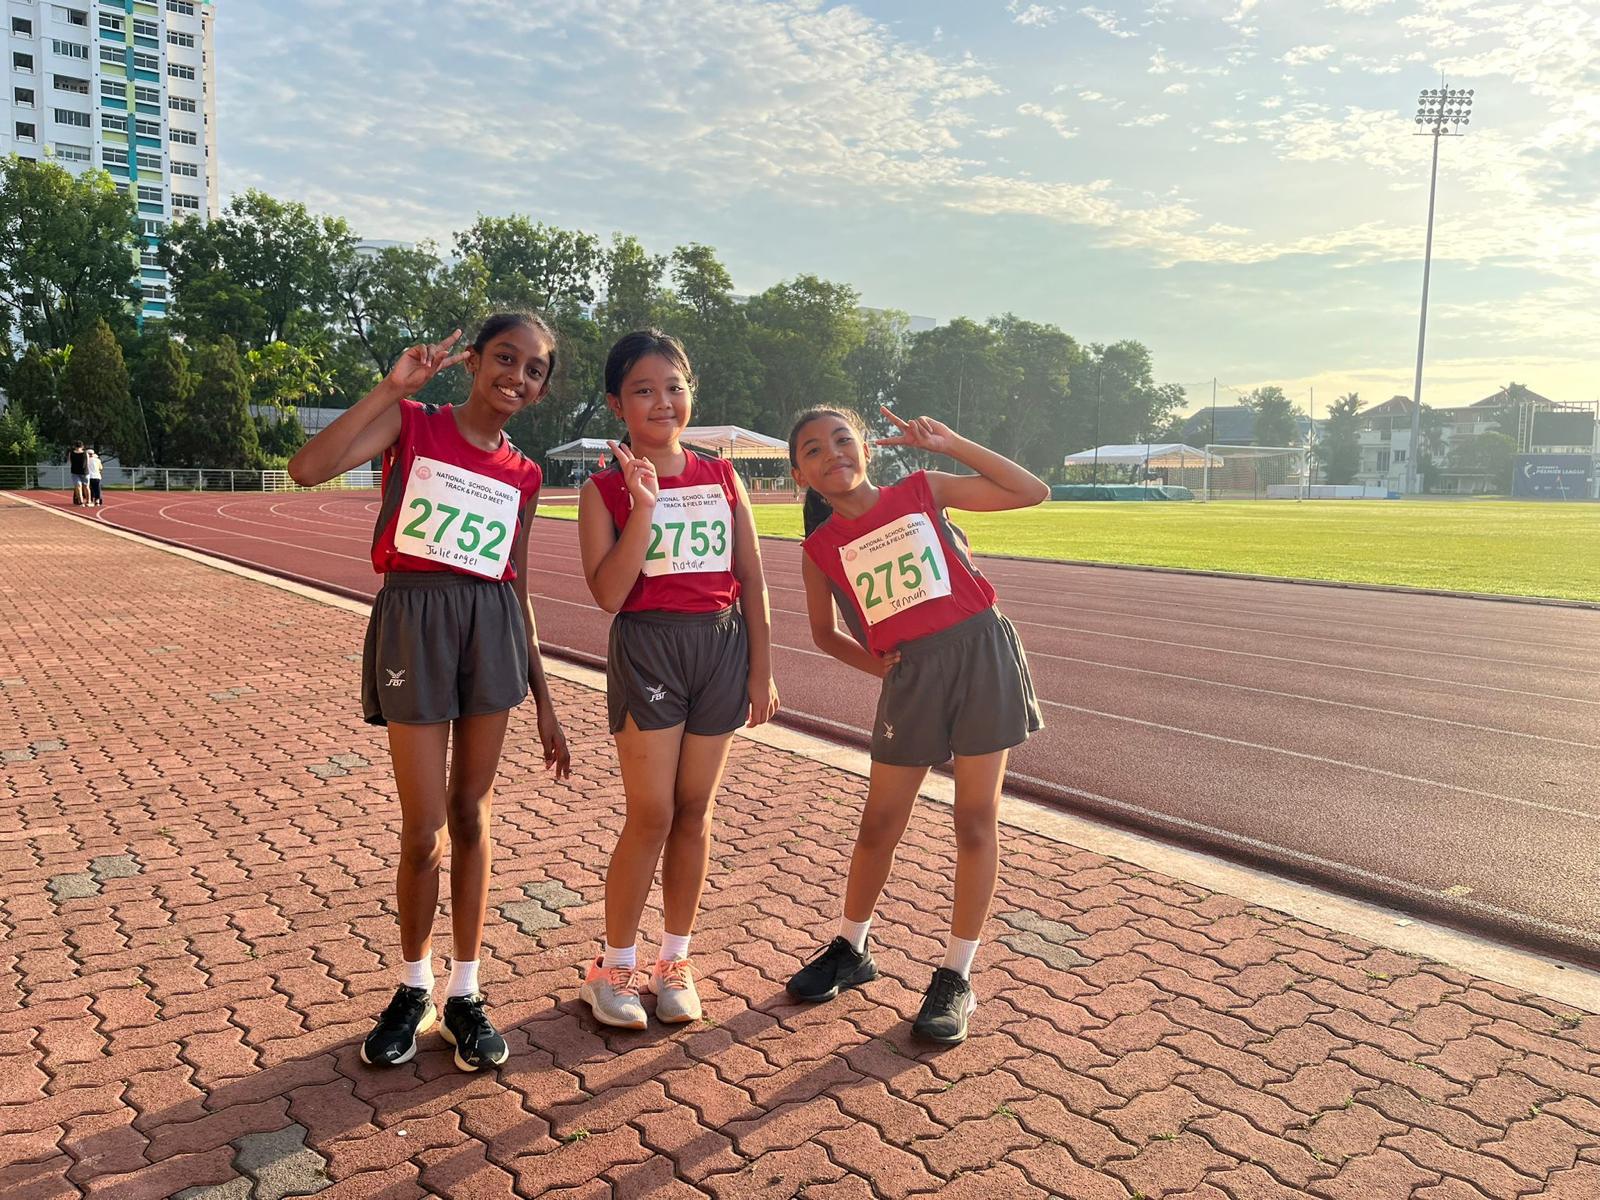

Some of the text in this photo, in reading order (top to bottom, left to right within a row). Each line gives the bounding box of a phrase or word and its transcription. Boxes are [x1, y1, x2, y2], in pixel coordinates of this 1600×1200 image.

[436, 471, 514, 501] NATIONAL SCHOOL GAMES
[445, 481, 466, 493] TRACK
[471, 489, 488, 500] FIELD
[488, 496, 504, 505] MEET
[402, 497, 507, 561] 2752
[645, 520, 726, 561] 2753
[859, 537, 883, 551] NATIONAL
[884, 527, 906, 540] SCHOOL
[869, 542, 886, 553] TRACK
[890, 534, 905, 544] FIELD
[905, 528, 920, 537] MEET
[855, 545, 942, 610] 2751
